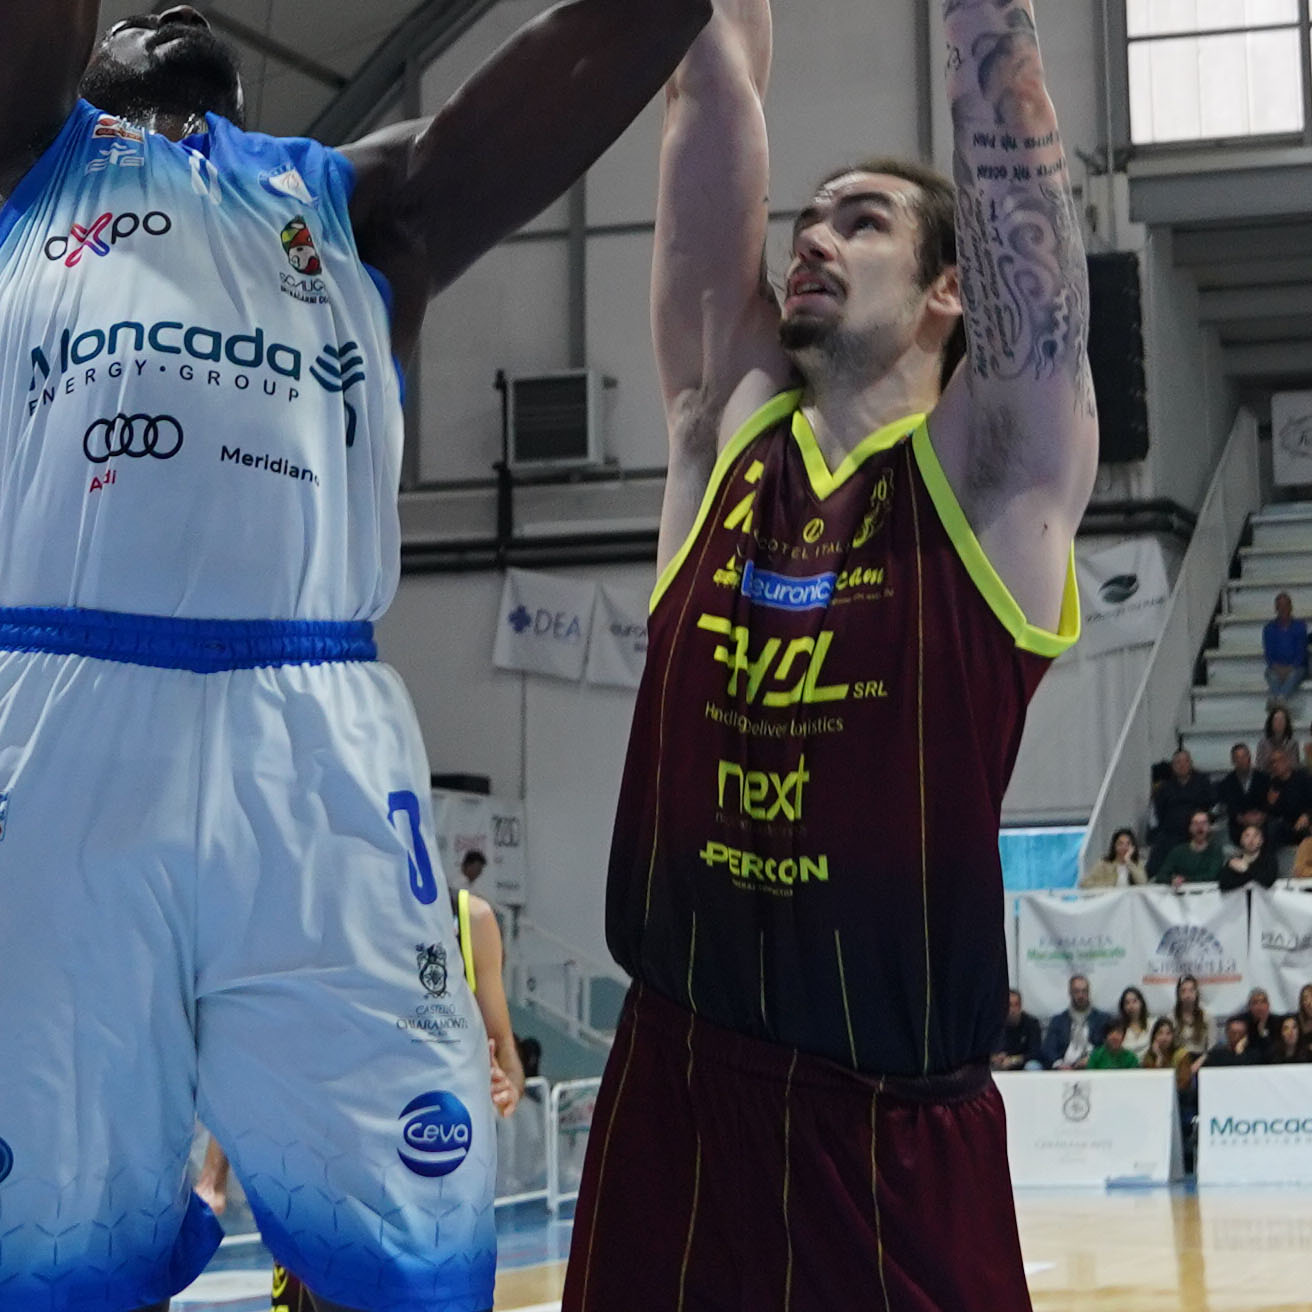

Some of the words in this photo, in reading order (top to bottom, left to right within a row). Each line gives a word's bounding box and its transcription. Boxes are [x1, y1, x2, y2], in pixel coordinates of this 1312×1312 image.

[28, 320, 303, 392] Moncada
[28, 359, 148, 417] ENERGY
[181, 364, 300, 404] GROUP
[852, 680, 889, 699] SRL
[717, 753, 810, 822] next
[699, 840, 829, 885] PERCON
[405, 1122, 469, 1144] ceva
